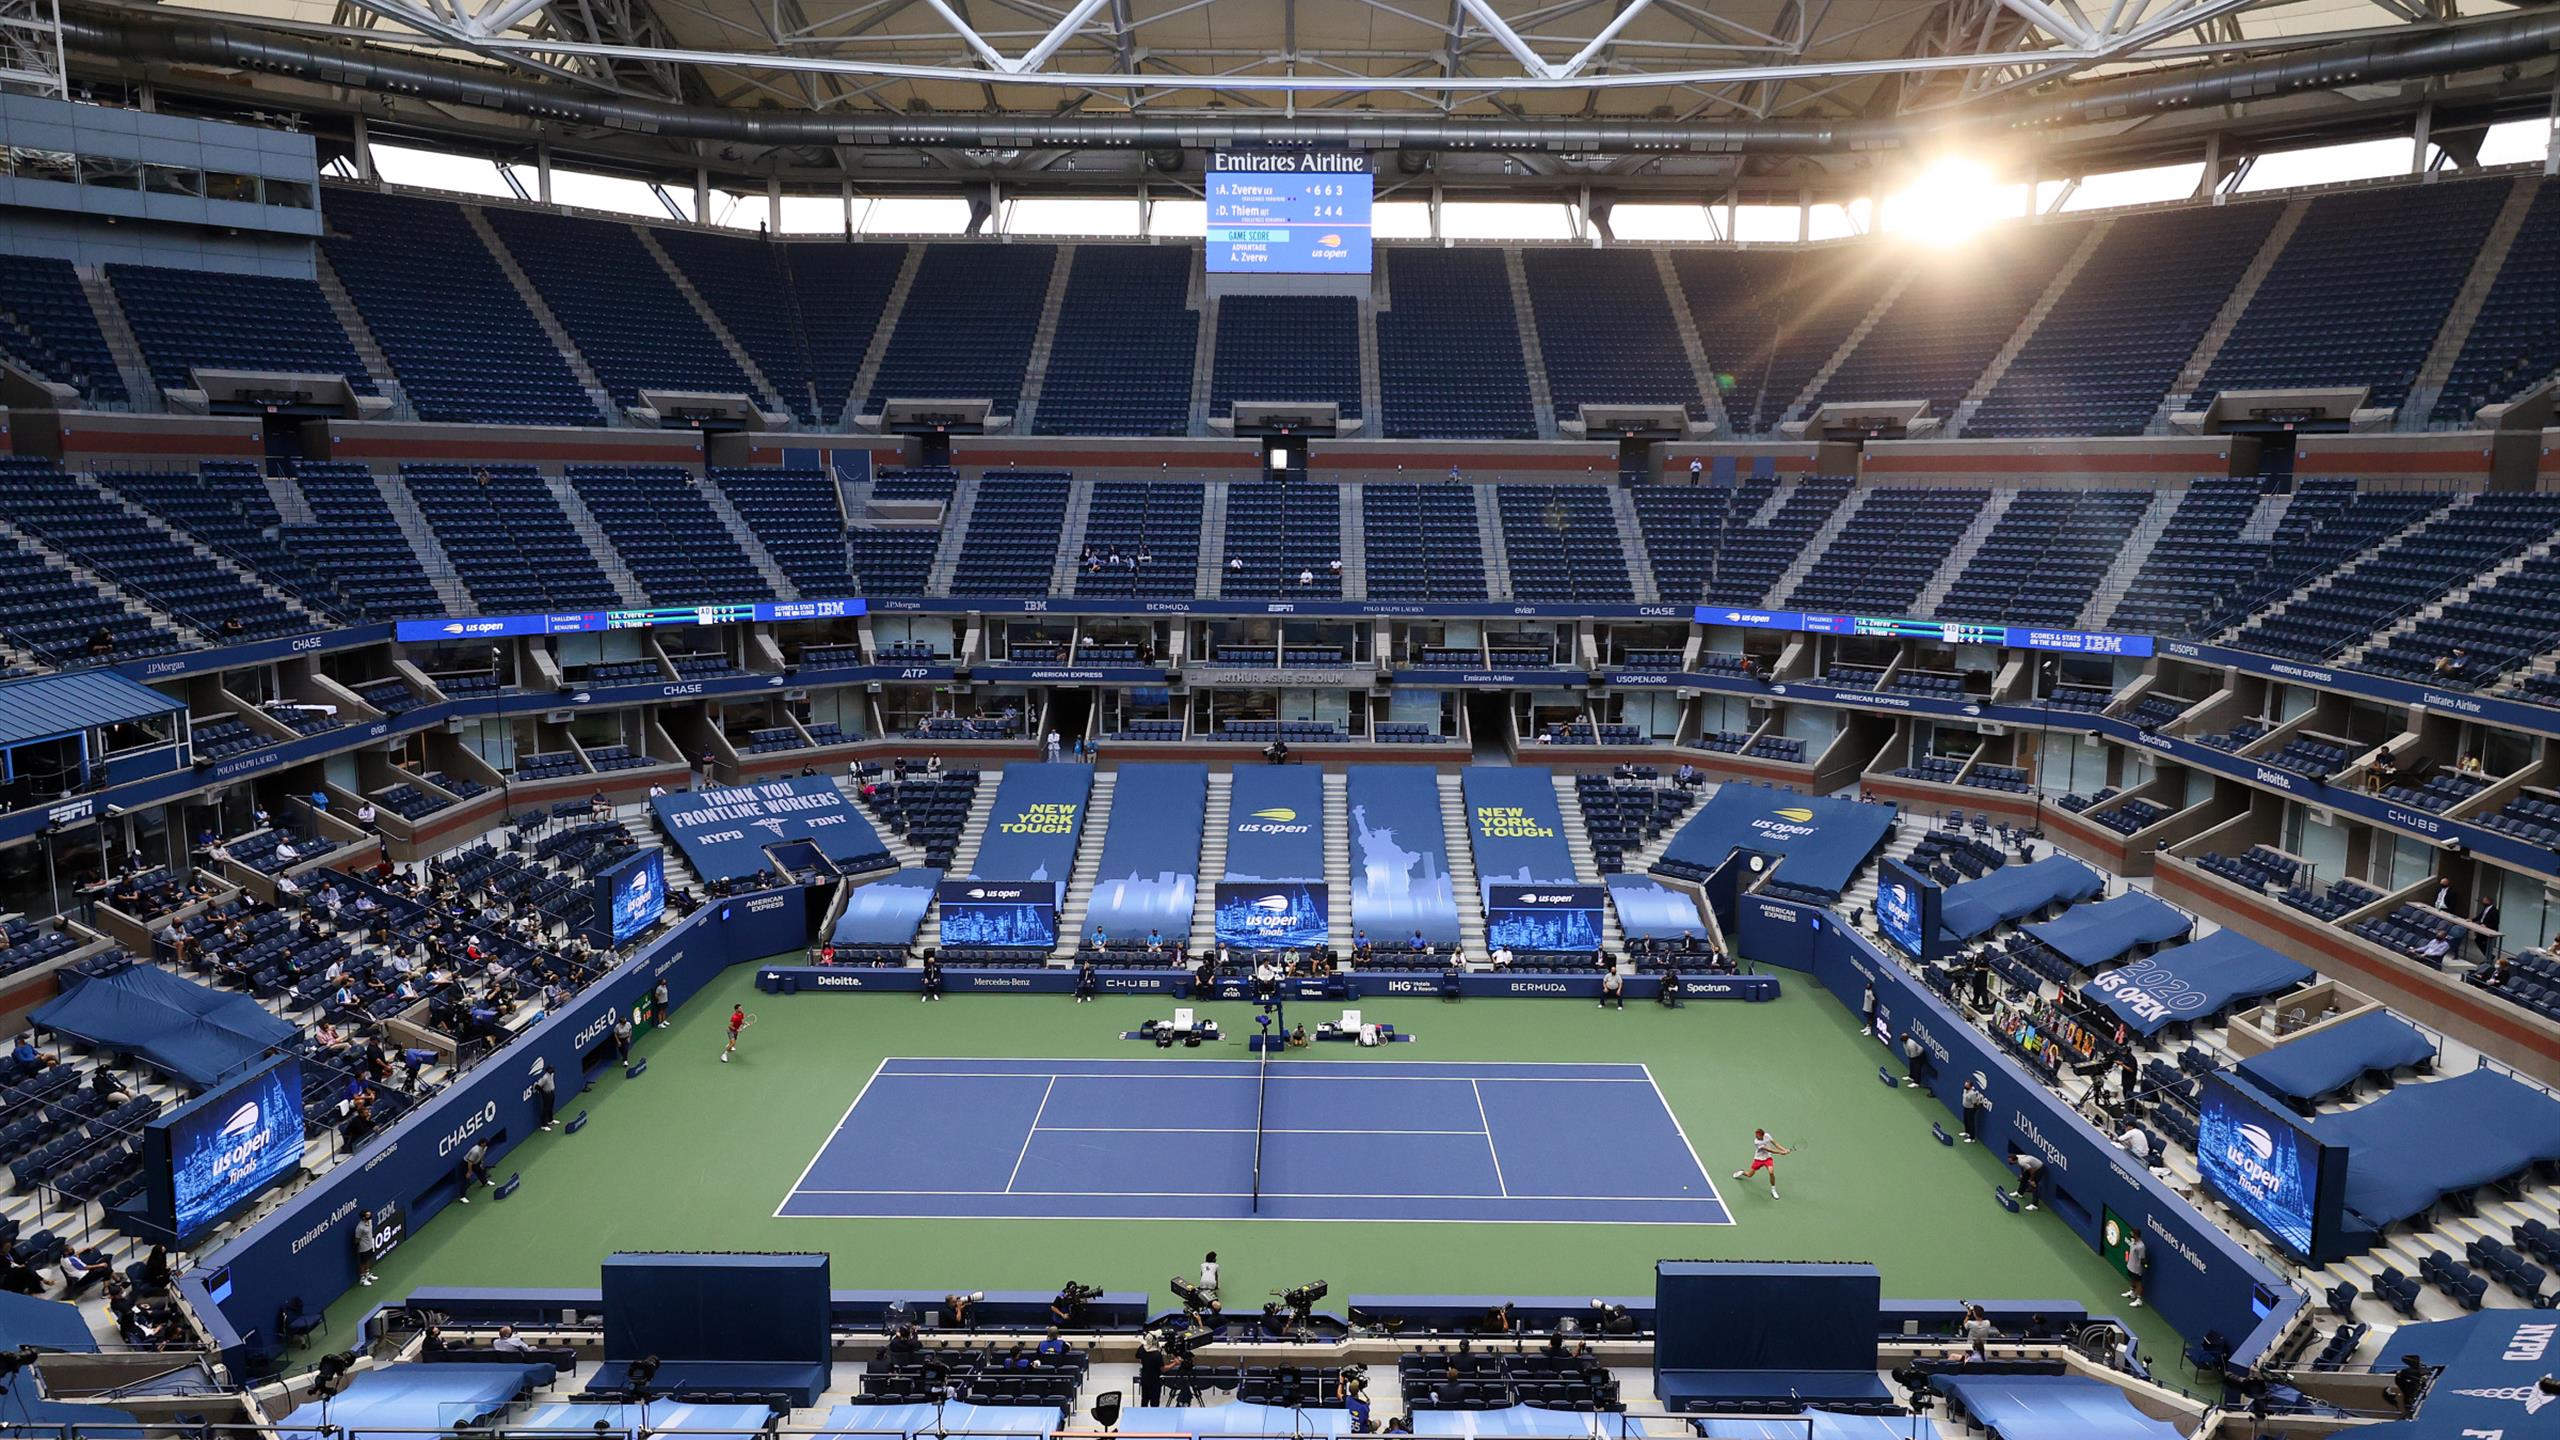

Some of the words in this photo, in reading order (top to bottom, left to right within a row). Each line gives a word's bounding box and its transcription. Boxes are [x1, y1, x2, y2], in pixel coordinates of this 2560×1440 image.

[1215, 153, 1296, 171] Emirates
[1301, 153, 1364, 172] Airline
[1231, 184, 1263, 195] Zverev
[1314, 185, 1321, 196] 6
[1325, 185, 1332, 196] 6
[1336, 185, 1343, 196] 3
[1231, 205, 1259, 216] Thiem
[1314, 206, 1321, 216] 2
[1325, 206, 1332, 216] 4
[1336, 206, 1343, 216] 4
[1229, 232, 1247, 240] GAME
[1249, 232, 1270, 241] SCORE
[1232, 244, 1267, 252] ADVANTAGE
[1231, 253, 1239, 262] A.
[1241, 252, 1268, 263] Zverev
[1312, 250, 1323, 258] us
[1324, 250, 1347, 260] open
[817, 602, 844, 616] IBM
[1024, 601, 1047, 611] IBM
[1146, 603, 1190, 611] BERMUDA
[1268, 604, 1294, 612] ESPN
[1514, 606, 1536, 614] evian
[1640, 607, 1675, 616] CHASE
[623, 611, 646, 619] Zverev
[1751, 615, 1770, 624] open
[466, 624, 478, 632] us
[478, 622, 504, 633] open
[1869, 619, 1890, 627] Zverev
[1869, 628, 1888, 636] Thiem
[2030, 632, 2054, 640] SCORES
[2062, 634, 2081, 642] STATS
[292, 638, 322, 651] CHASE
[2062, 640, 2081, 648] CLOUD
[2084, 635, 2122, 652] IBM
[2170, 642, 2198, 657] #USOPEN
[901, 668, 928, 678] ATP
[1031, 671, 1068, 679] AMERICAN
[1070, 671, 1104, 679] EXPRESS
[1216, 672, 1259, 684] ARTHUR
[1263, 673, 1293, 684] ASHE
[1295, 673, 1344, 685] STADIUM
[1463, 674, 1490, 682] Emirates
[1491, 674, 1514, 682] Airline
[2270, 664, 2301, 677] AMERICAN
[2302, 668, 2332, 682] EXPRESS
[1616, 675, 1667, 684] USOPEN.ORG
[664, 684, 702, 696] CHASE
[1835, 693, 1875, 704] AMERICAN
[1877, 696, 1910, 707] EXPRESS
[2423, 693, 2454, 708] Emirates
[2455, 699, 2481, 713] Airline
[370, 723, 387, 736] evian
[2138, 731, 2169, 749] Spectrum
[216, 765, 234, 776] POLO
[235, 759, 255, 772] RALPH
[255, 754, 278, 768] LAUREN
[2256, 767, 2291, 790] Deloitte.
[700, 787, 759, 807] THANK
[761, 782, 794, 798] YOU
[670, 802, 764, 828] FRONTLINE
[764, 791, 841, 814] WORKERS
[1029, 803, 1077, 814] NEW
[1477, 807, 1523, 817] NEW
[805, 815, 847, 828] FDNY
[1017, 813, 1073, 825] YORK
[1478, 817, 1536, 827] YORK
[2387, 809, 2438, 832] CHUBB
[1000, 823, 1073, 834] TOUGH
[1238, 823, 1261, 832] us
[1263, 824, 1308, 835] open
[1480, 827, 1553, 837] TOUGH
[1751, 818, 1771, 831] us
[1771, 822, 1815, 837] open
[697, 829, 744, 845] NYPD
[1759, 830, 1791, 842] finals
[635, 890, 651, 911] open
[986, 890, 998, 898] us
[998, 889, 1021, 900] open
[1538, 894, 1549, 902] us
[1549, 894, 1572, 904] open
[746, 895, 783, 907] AMERICAN
[751, 901, 785, 912] EXPRESS
[1759, 904, 1797, 917] AMERICAN
[1894, 906, 1910, 923] open
[1246, 915, 1265, 926] us
[1266, 915, 1297, 929] open
[1764, 911, 1797, 923] EXPRESS
[1259, 928, 1284, 937] finals
[817, 975, 862, 986] Deloitte.
[974, 977, 1030, 986] Mercedes-Benz
[1106, 979, 1160, 988] CHUBB
[1388, 981, 1411, 991] IHG
[2116, 959, 2207, 1011] 2020
[1511, 983, 1568, 991] BERMUDA
[1686, 982, 1729, 994] Spectrum
[1222, 990, 1241, 998] evian
[2093, 970, 2128, 992] US
[2114, 987, 2173, 1022] OPEN
[574, 1017, 607, 1050] CHASE
[1910, 1017, 1950, 1064] J.P.Morgan
[523, 1085, 533, 1102] us
[439, 1110, 484, 1157] CHASE
[2013, 1110, 2068, 1172] J.P.Morgan
[212, 1151, 231, 1177] us
[231, 1128, 271, 1164] open
[364, 1143, 398, 1171] USOPEN.ORG
[229, 1157, 257, 1185] finals
[2227, 1144, 2244, 1167] us
[2244, 1158, 2280, 1193] open
[2110, 1160, 2140, 1191] USOPEN.ORG
[2238, 1174, 2265, 1200] finals
[377, 1200, 396, 1225] IBM
[291, 1217, 329, 1255] Emirates
[330, 1197, 358, 1230] Airline
[372, 1226, 391, 1253] 108
[2147, 1213, 2180, 1250] Emirates
[2179, 1243, 2207, 1275] Airline
[2502, 1324, 2558, 1361] NYPD
